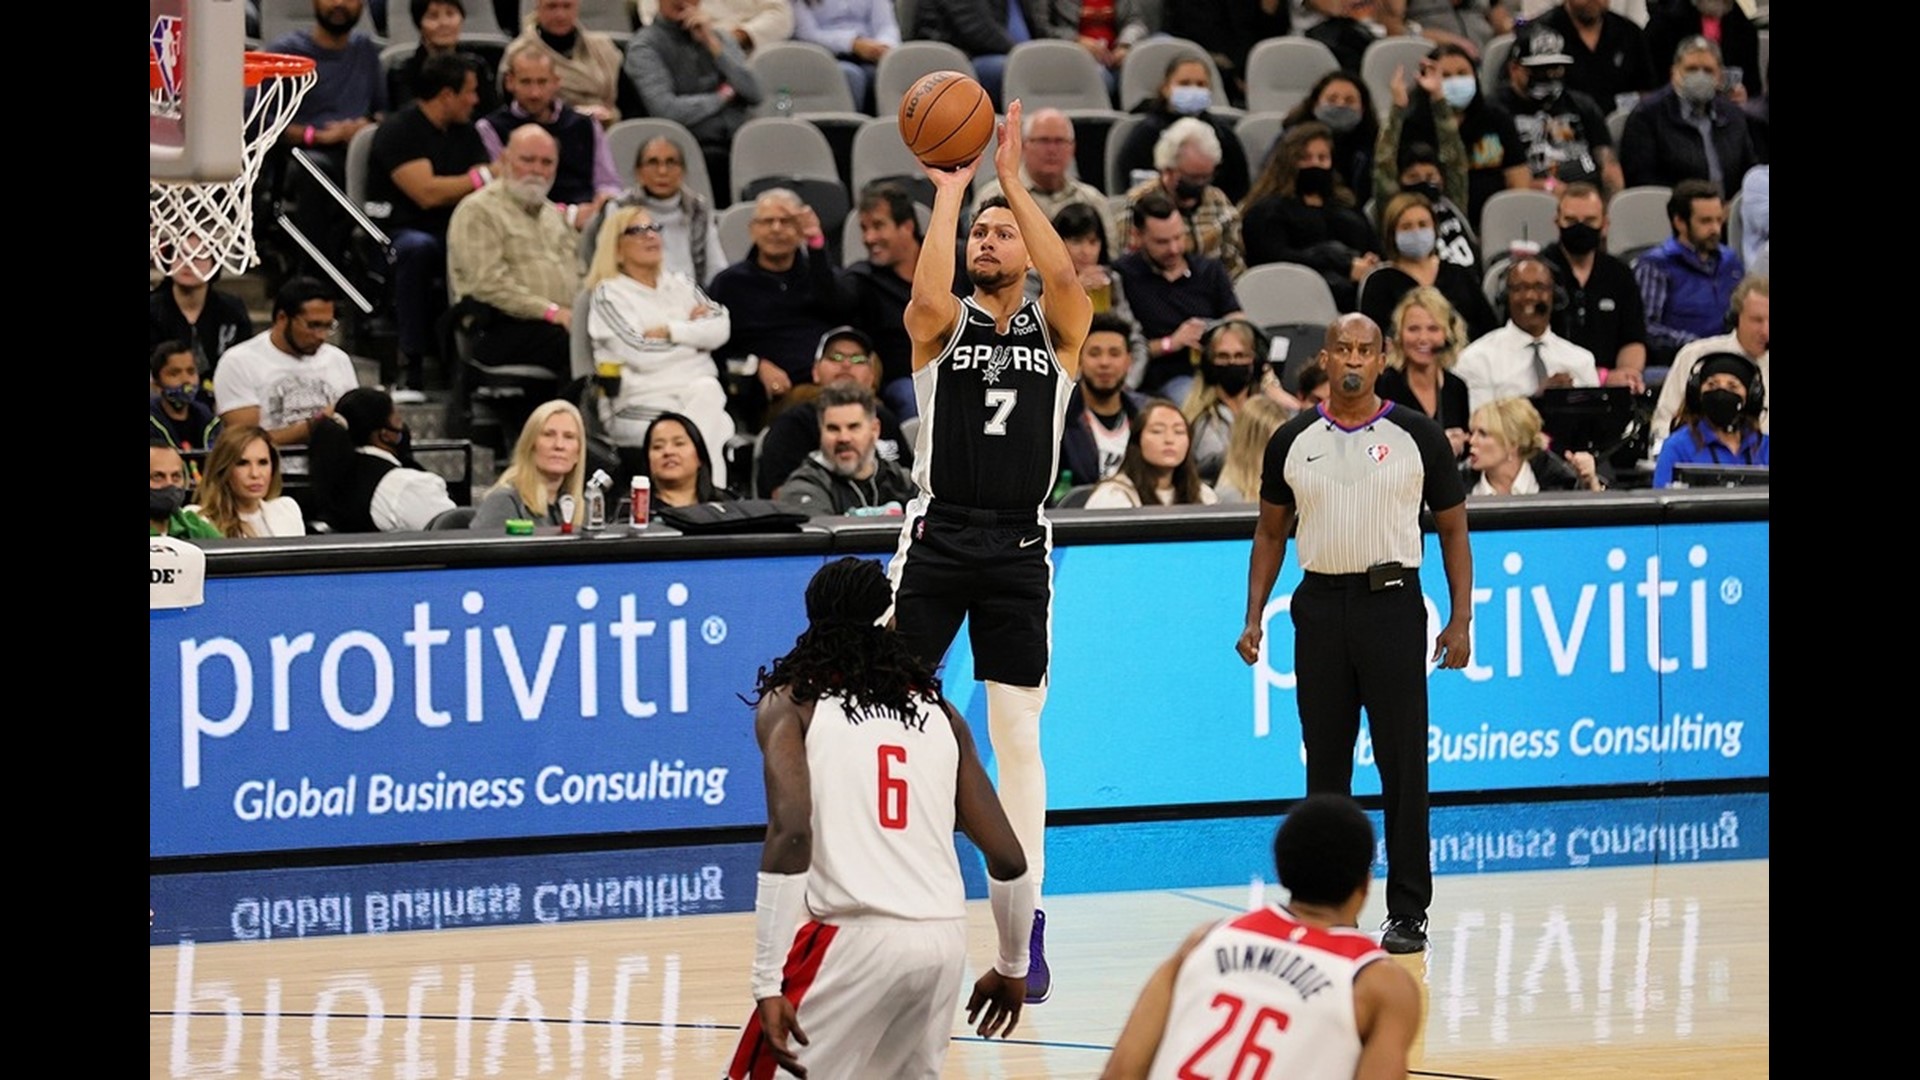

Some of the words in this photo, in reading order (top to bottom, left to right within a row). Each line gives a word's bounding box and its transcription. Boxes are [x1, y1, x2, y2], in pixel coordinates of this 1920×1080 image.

[952, 344, 1049, 385] SPURS
[984, 388, 1018, 436] 7
[1569, 712, 1744, 758] Consulting
[233, 774, 357, 821] Global
[367, 770, 525, 814] Business
[535, 759, 729, 806] Consulting
[877, 743, 908, 831] 6
[1176, 992, 1291, 1080] 26
